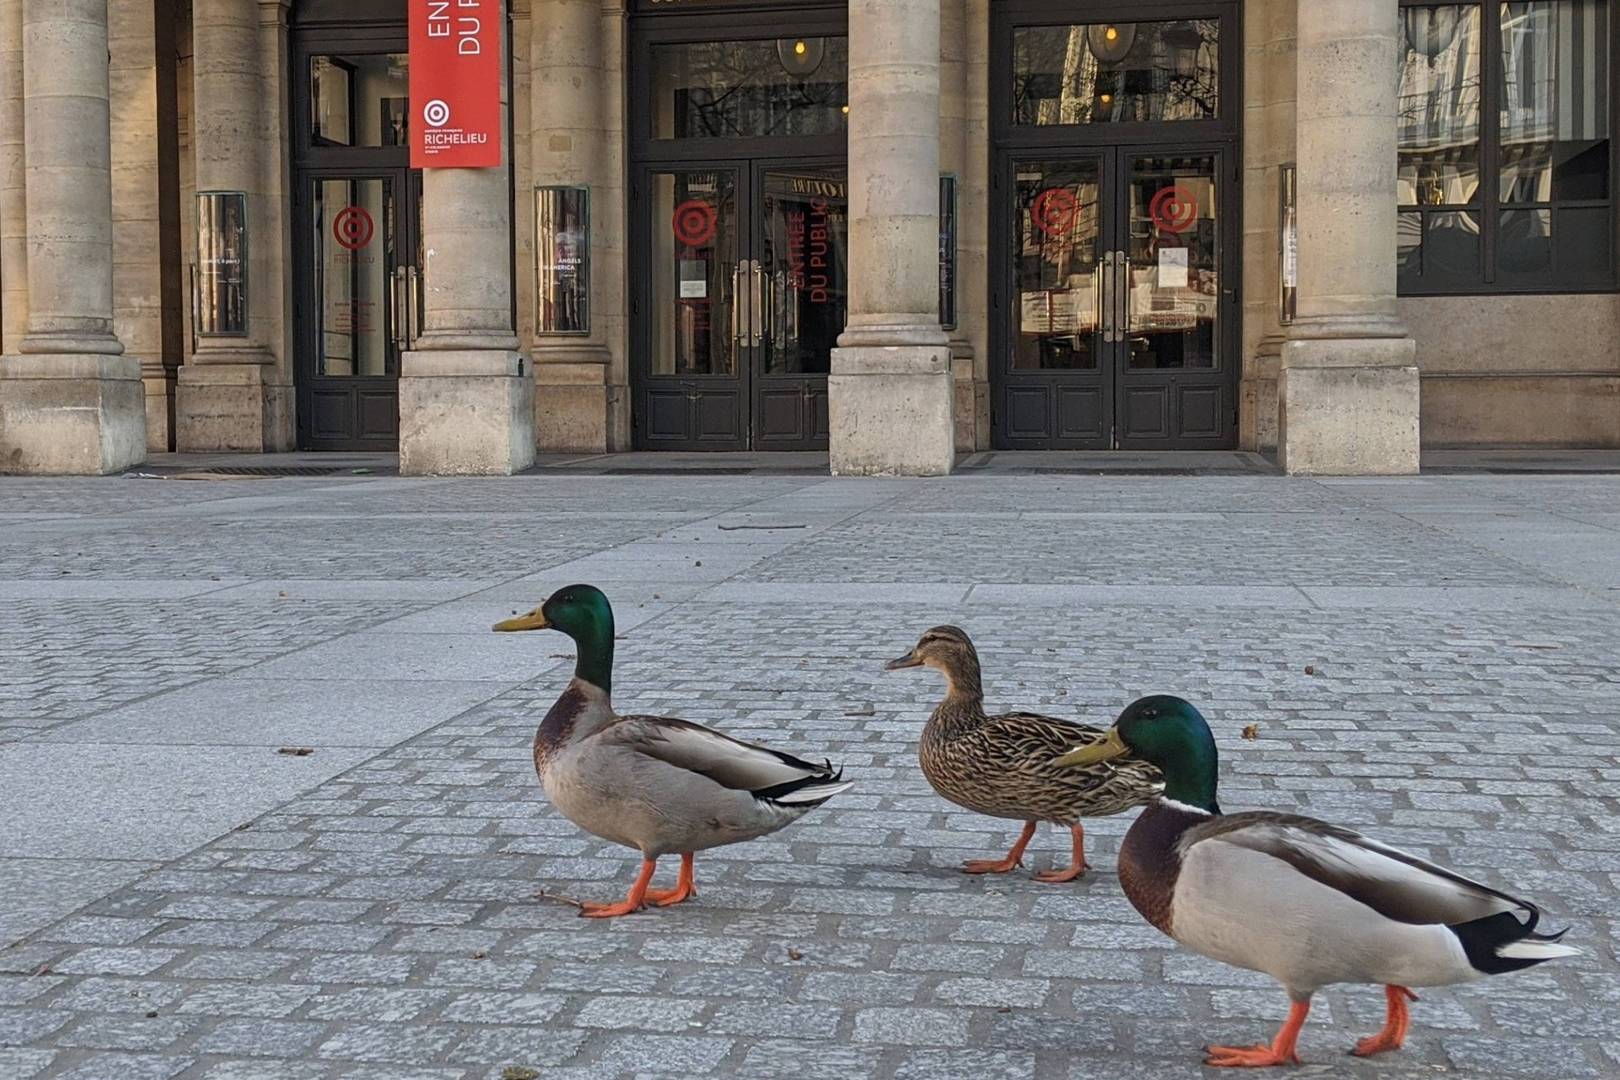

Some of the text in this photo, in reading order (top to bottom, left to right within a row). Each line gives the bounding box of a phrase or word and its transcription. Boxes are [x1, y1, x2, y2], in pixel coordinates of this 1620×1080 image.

[459, 19, 480, 54] DU
[424, 133, 487, 144] RICHELIEU
[811, 196, 828, 303] DU PUBLIC
